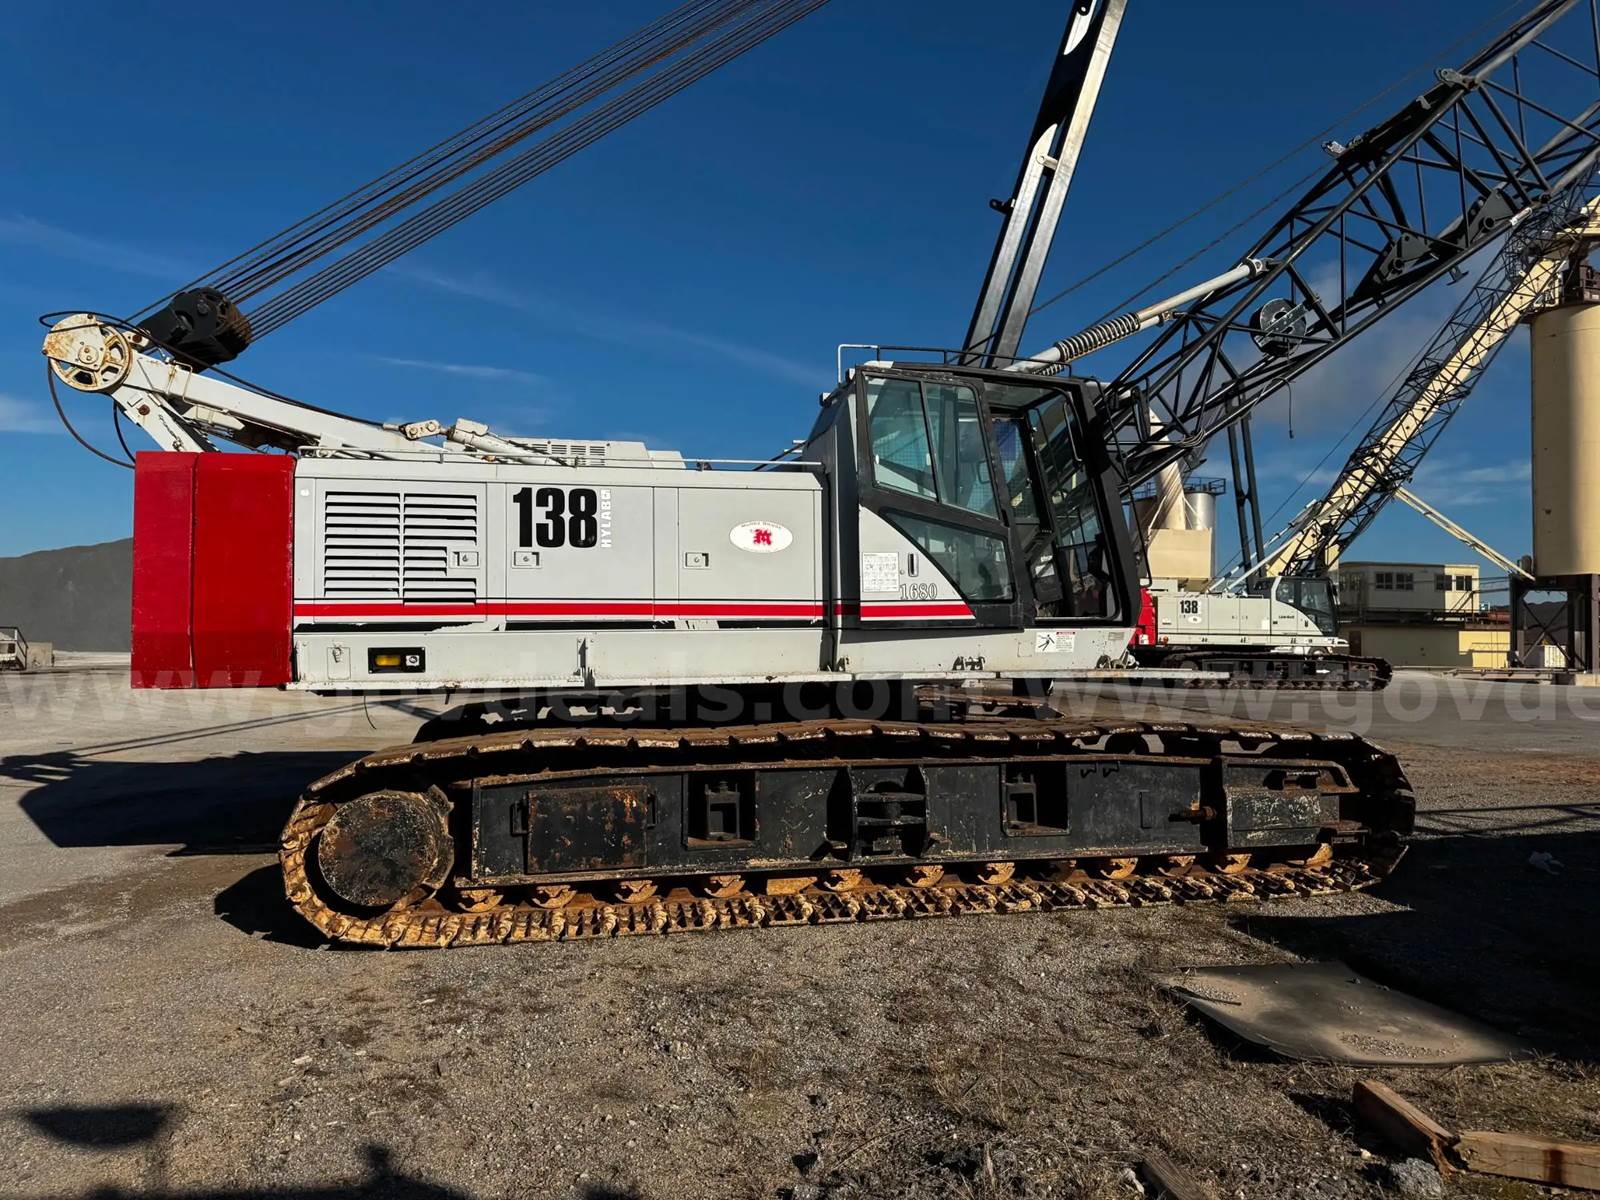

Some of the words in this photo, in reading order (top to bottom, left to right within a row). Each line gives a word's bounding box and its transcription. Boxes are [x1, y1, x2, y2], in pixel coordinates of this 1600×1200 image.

[513, 487, 597, 548] 138
[899, 583, 938, 600] 1680
[1180, 600, 1198, 614] 138
